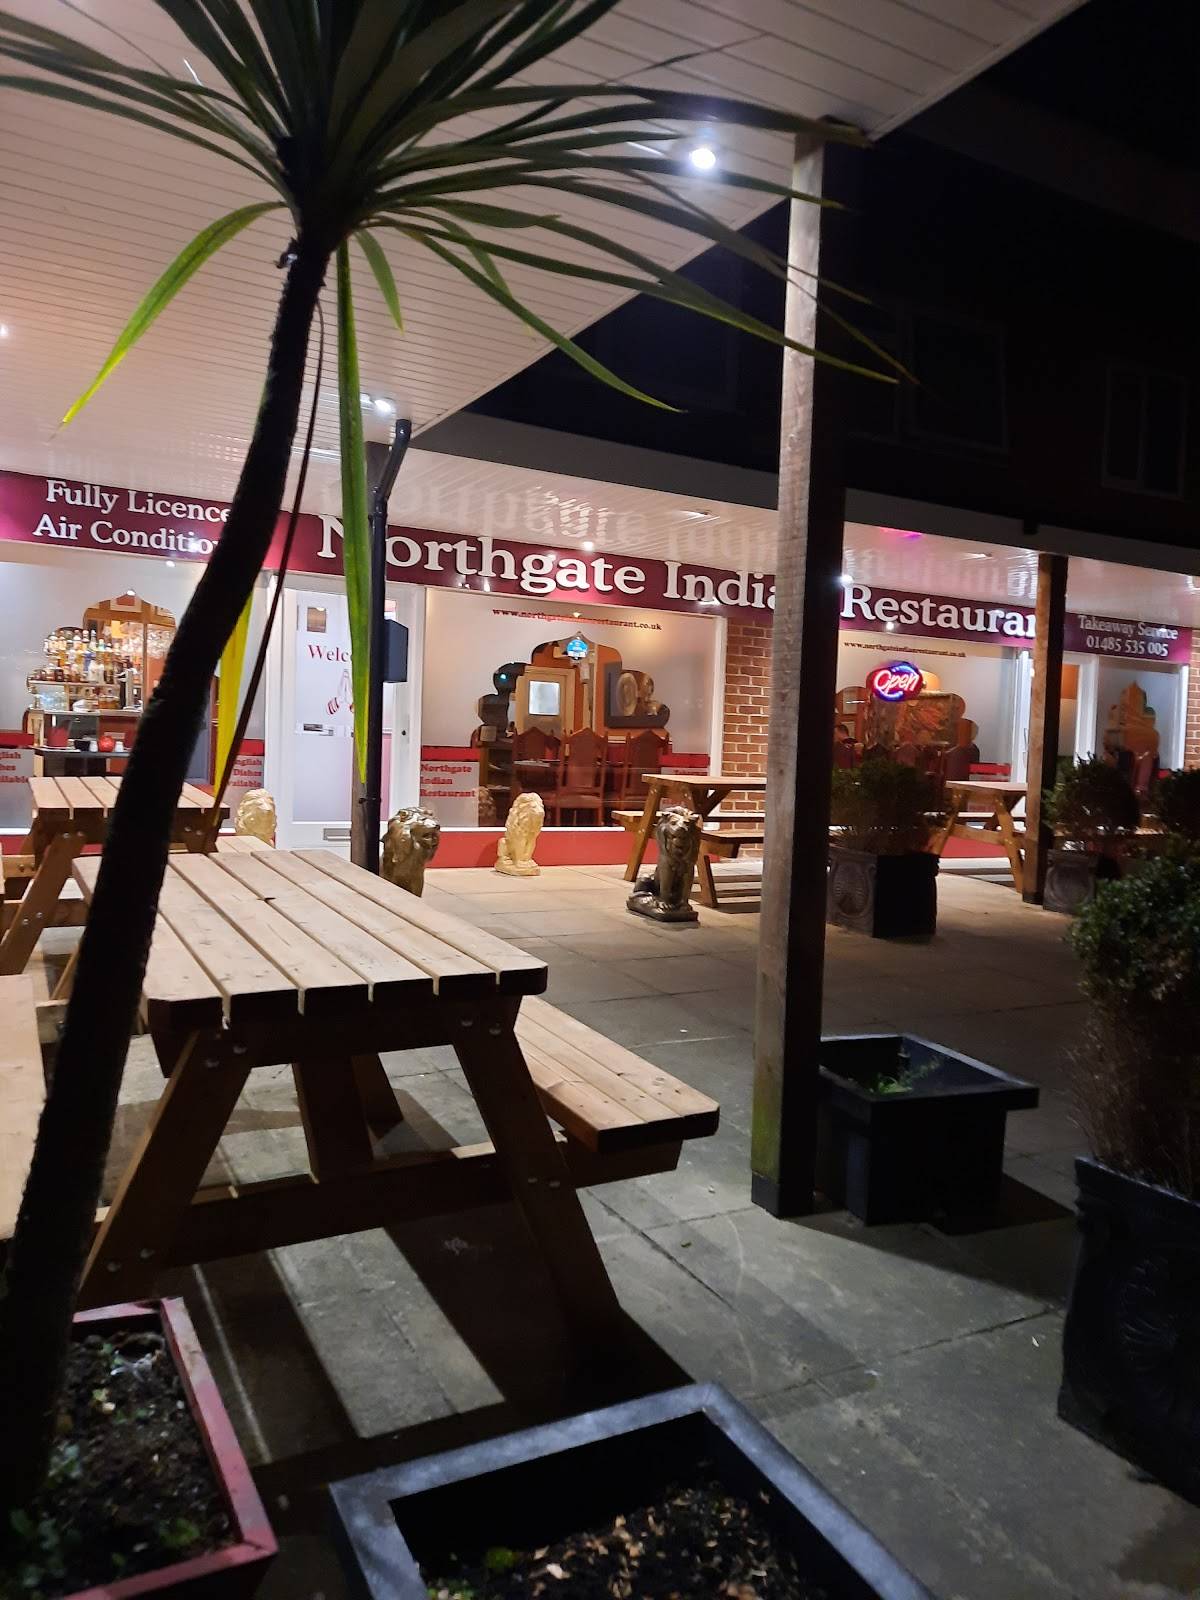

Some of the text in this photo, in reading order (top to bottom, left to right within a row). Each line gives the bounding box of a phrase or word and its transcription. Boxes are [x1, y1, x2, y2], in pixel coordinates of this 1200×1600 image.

[46, 480, 119, 514] Fully
[32, 513, 82, 541] Air
[316, 514, 646, 595] Northgate
[1078, 615, 1178, 640] Takeaway Service
[1086, 635, 1169, 657] 01485 535 005
[874, 669, 919, 694] Open
[420, 764, 472, 774] Northgate
[420, 789, 476, 797] Restaurant
